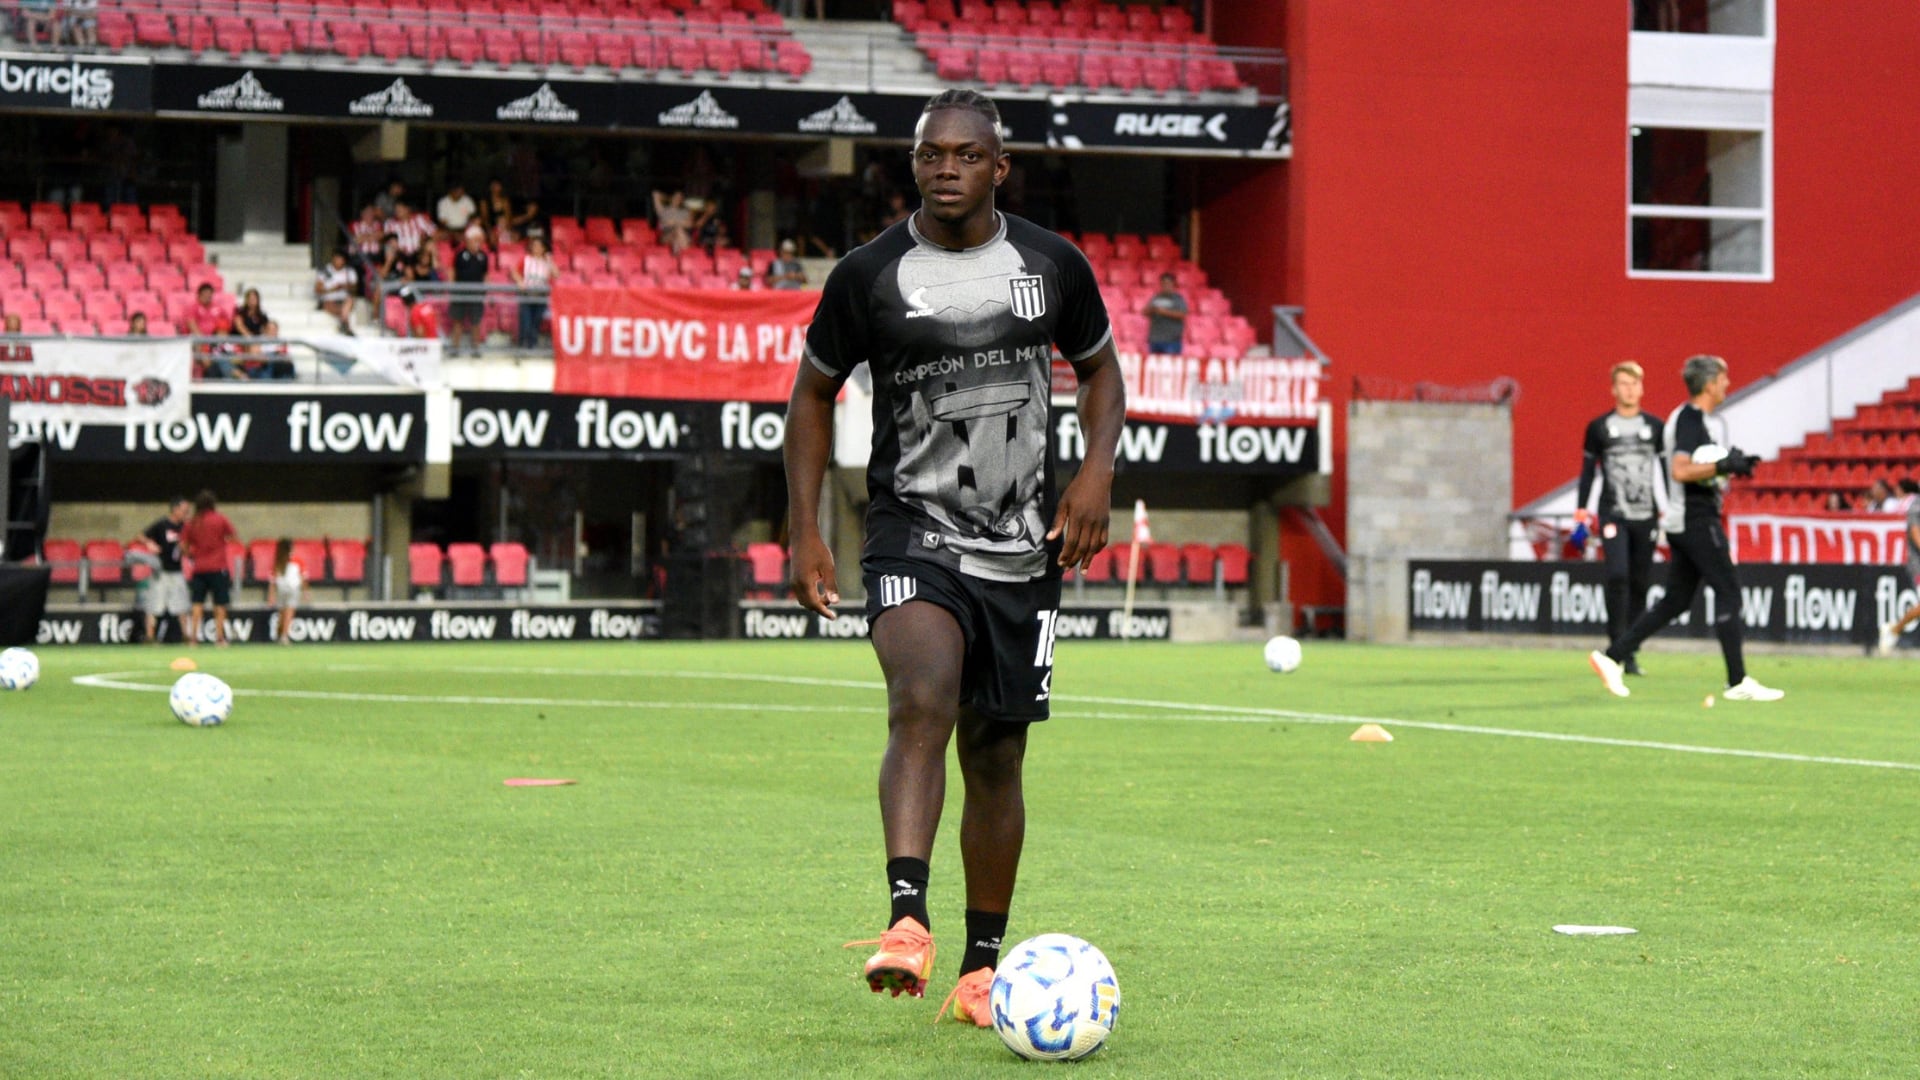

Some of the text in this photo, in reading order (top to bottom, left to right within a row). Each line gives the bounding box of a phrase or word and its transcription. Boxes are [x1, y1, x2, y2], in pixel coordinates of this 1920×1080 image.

[1114, 112, 1204, 136] RUGE
[906, 308, 934, 319] RUGE
[559, 315, 808, 364] UTEDYC LA PLA
[894, 355, 965, 385] CAMPEÓN
[974, 349, 1010, 368] DEL
[287, 401, 413, 452] flow
[451, 397, 549, 447] low
[720, 402, 788, 450] flo
[1412, 568, 1472, 619] flow
[1480, 570, 1542, 621] flow
[1784, 574, 1857, 630] flow
[269, 612, 336, 641] fow
[349, 611, 416, 640] flow
[430, 609, 497, 639] flow
[510, 609, 576, 638] flow
[745, 609, 808, 637] flow
